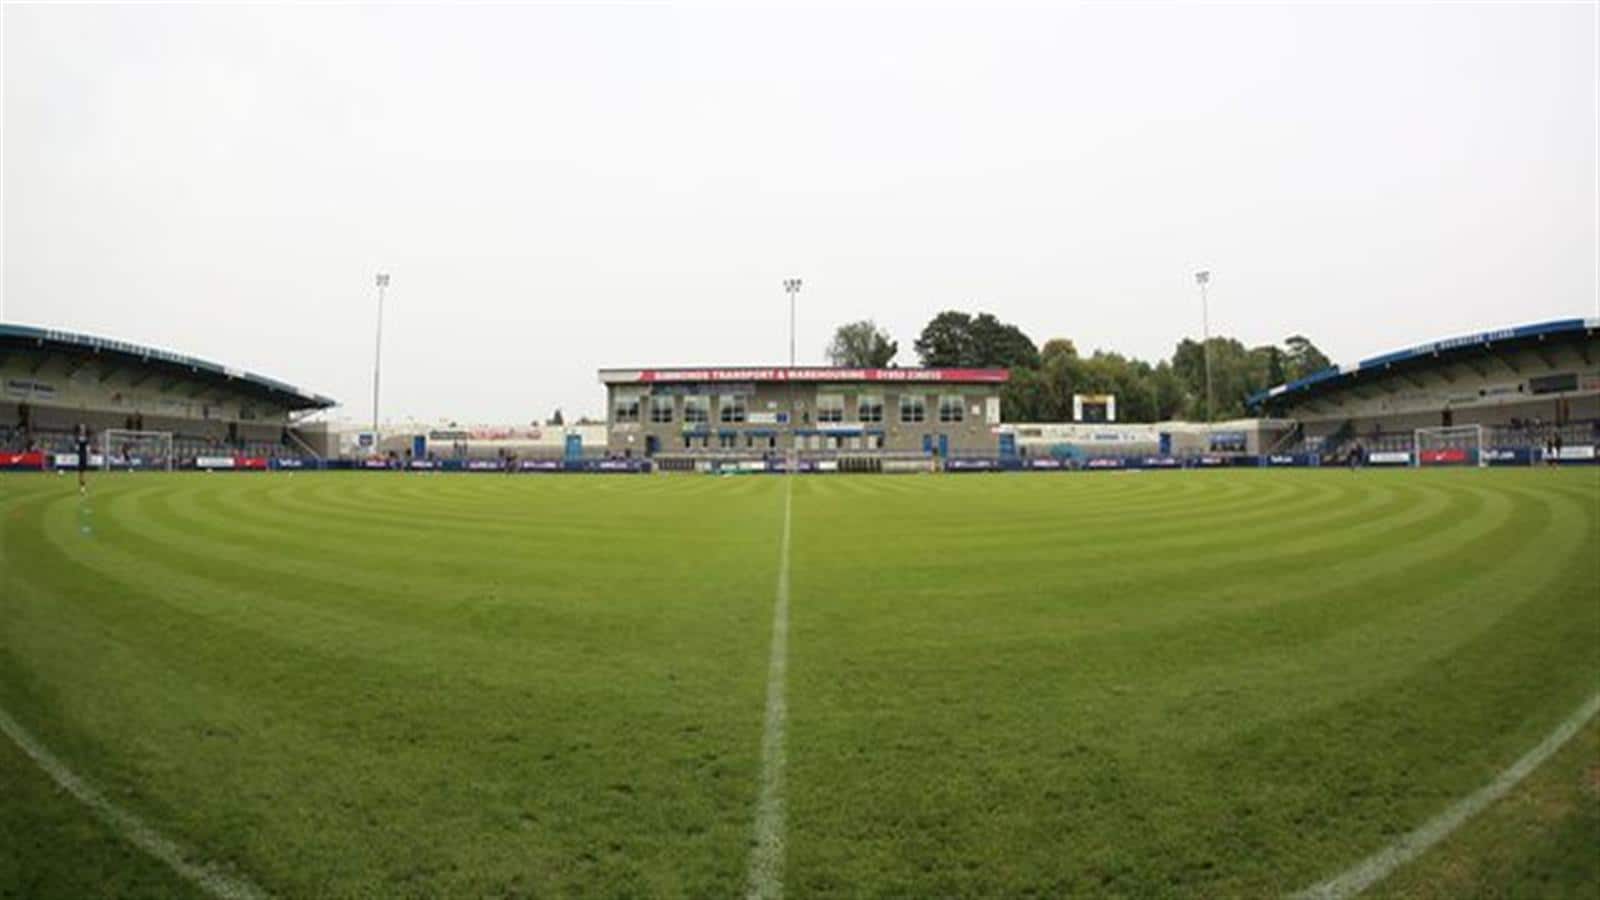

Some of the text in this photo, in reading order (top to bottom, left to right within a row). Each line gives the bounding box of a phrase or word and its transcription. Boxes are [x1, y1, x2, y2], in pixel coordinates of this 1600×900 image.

[712, 369, 773, 380] TRANSPORT
[777, 369, 786, 380] &
[788, 369, 865, 380] WAREHOUSING
